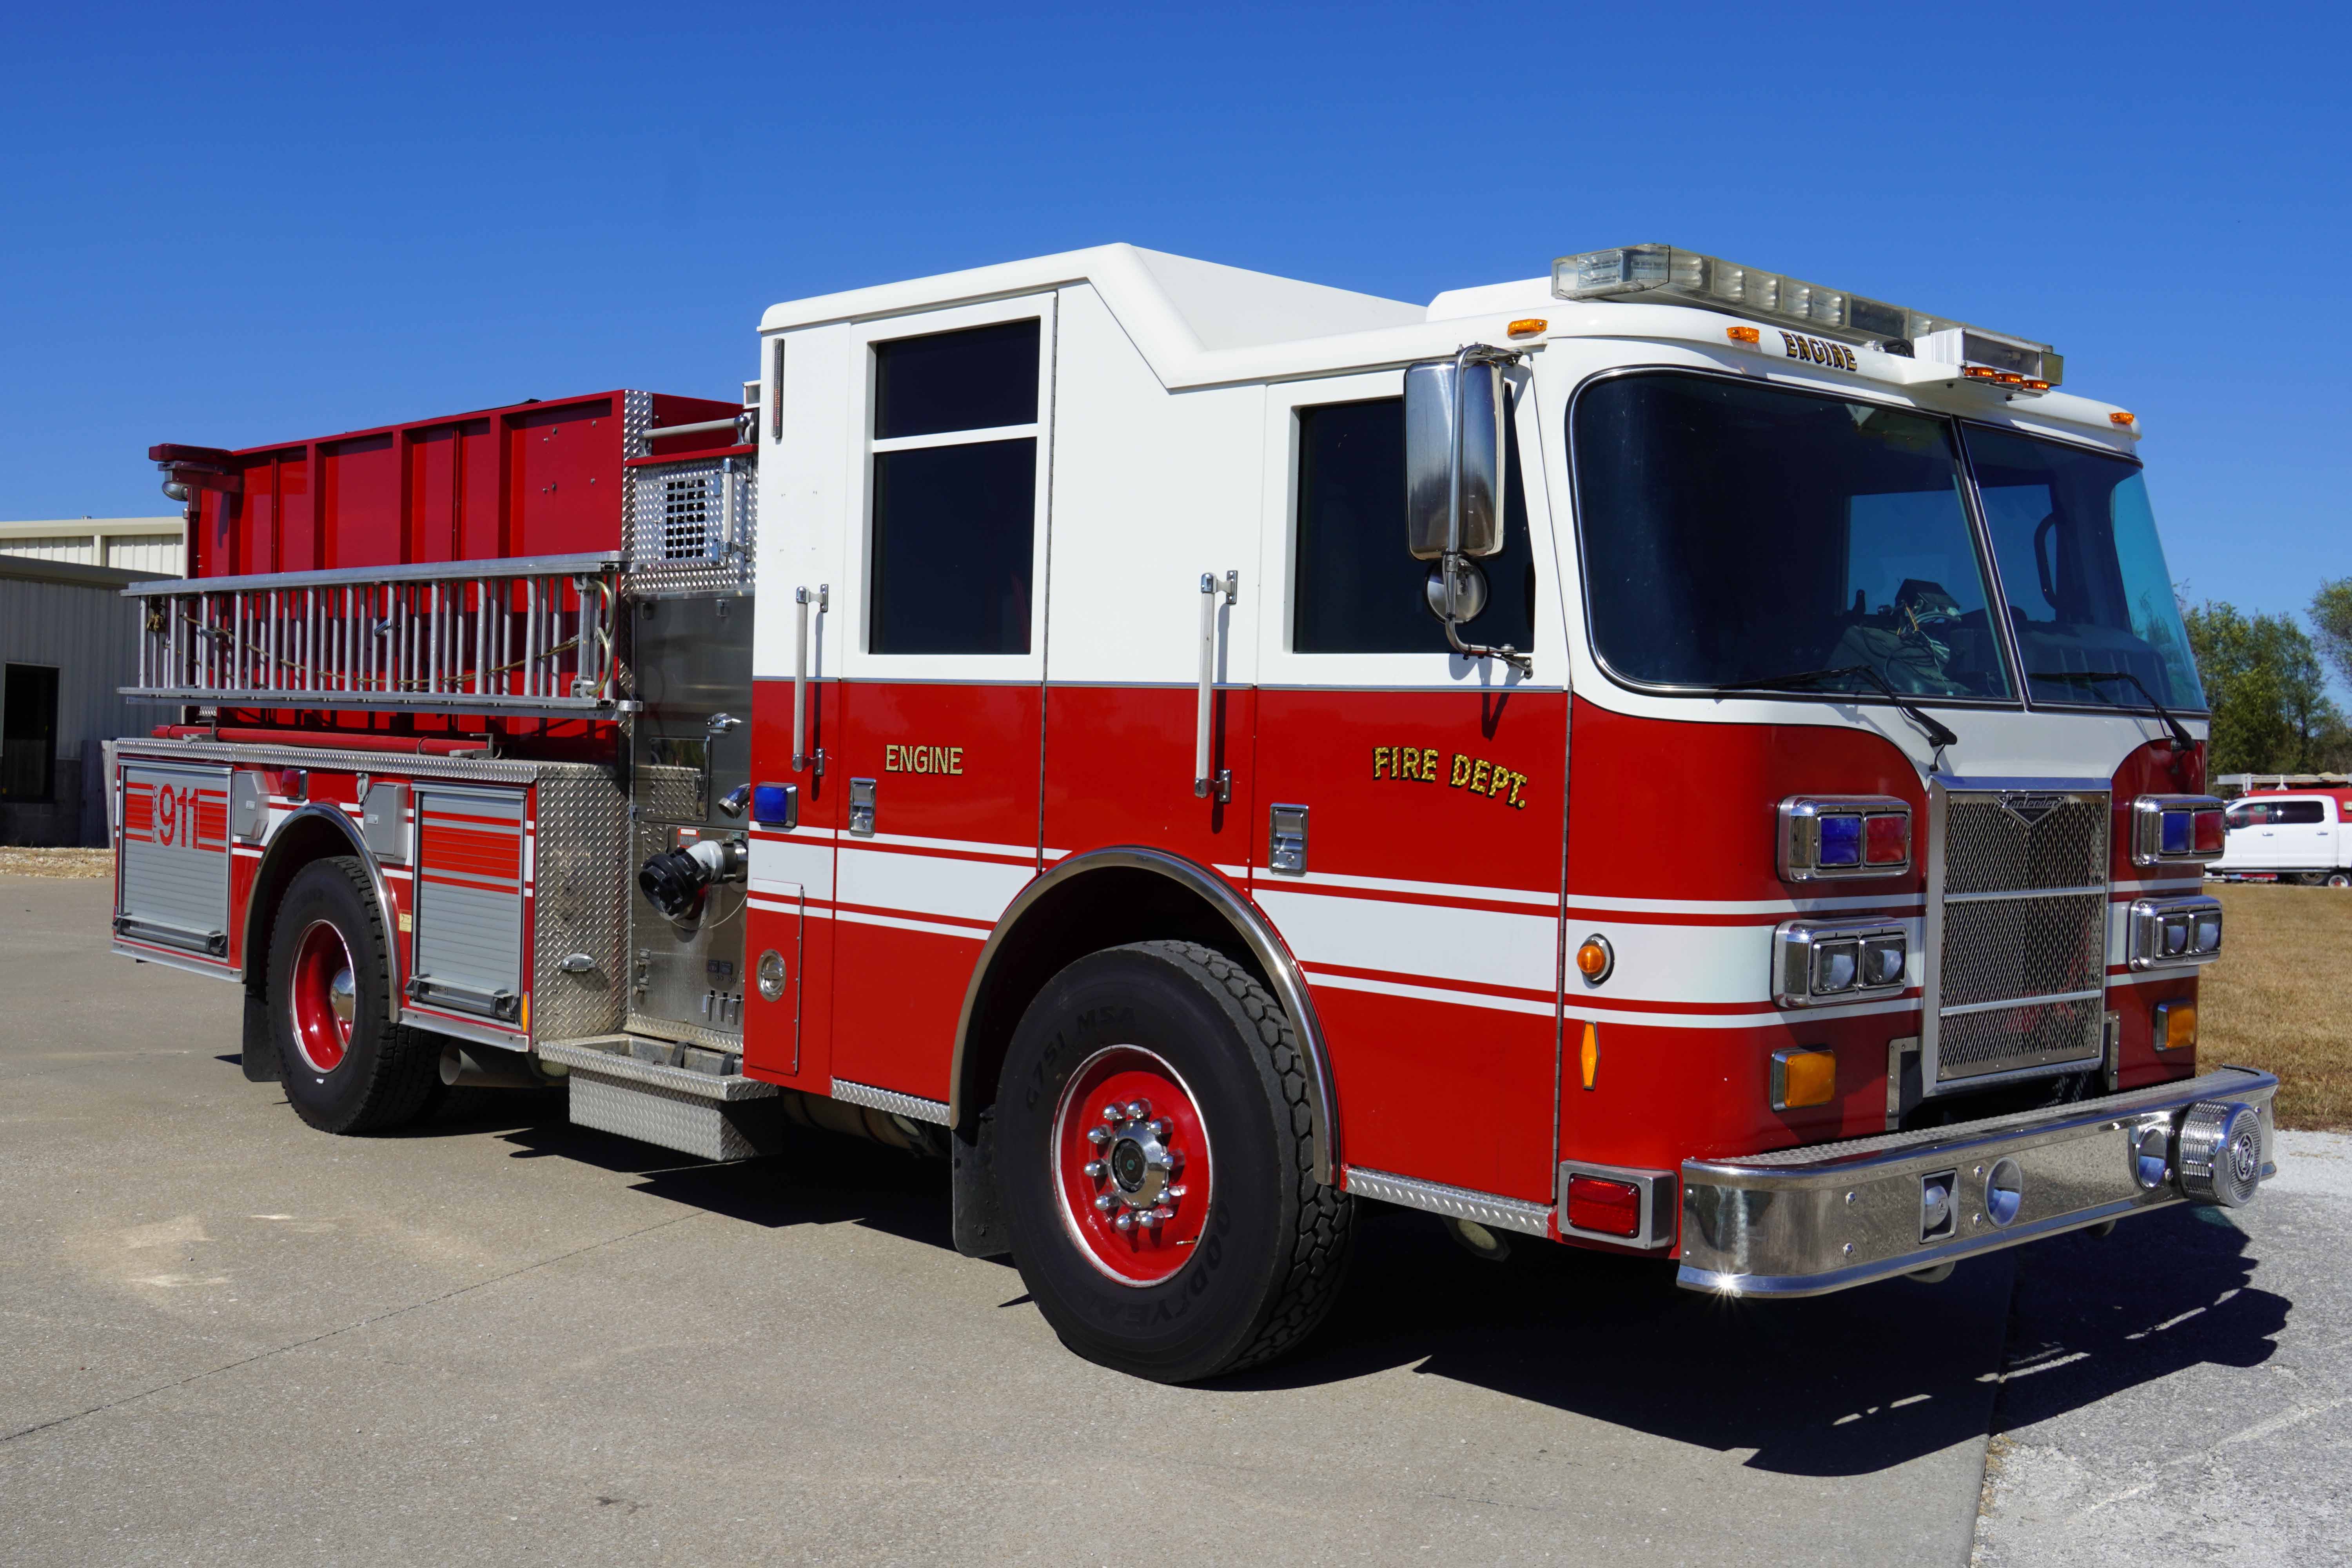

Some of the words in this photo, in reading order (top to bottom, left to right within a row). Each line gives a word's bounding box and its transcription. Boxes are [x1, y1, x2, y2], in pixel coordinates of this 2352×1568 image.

[1779, 330, 1857, 372] ENGINE
[885, 744, 964, 775] ENGINE
[1372, 746, 1439, 783] FIRE
[1449, 753, 1528, 810] DEPT.
[159, 783, 199, 849] 911
[2002, 792, 2059, 809] Contender
[1076, 1004, 1136, 1035] MSA
